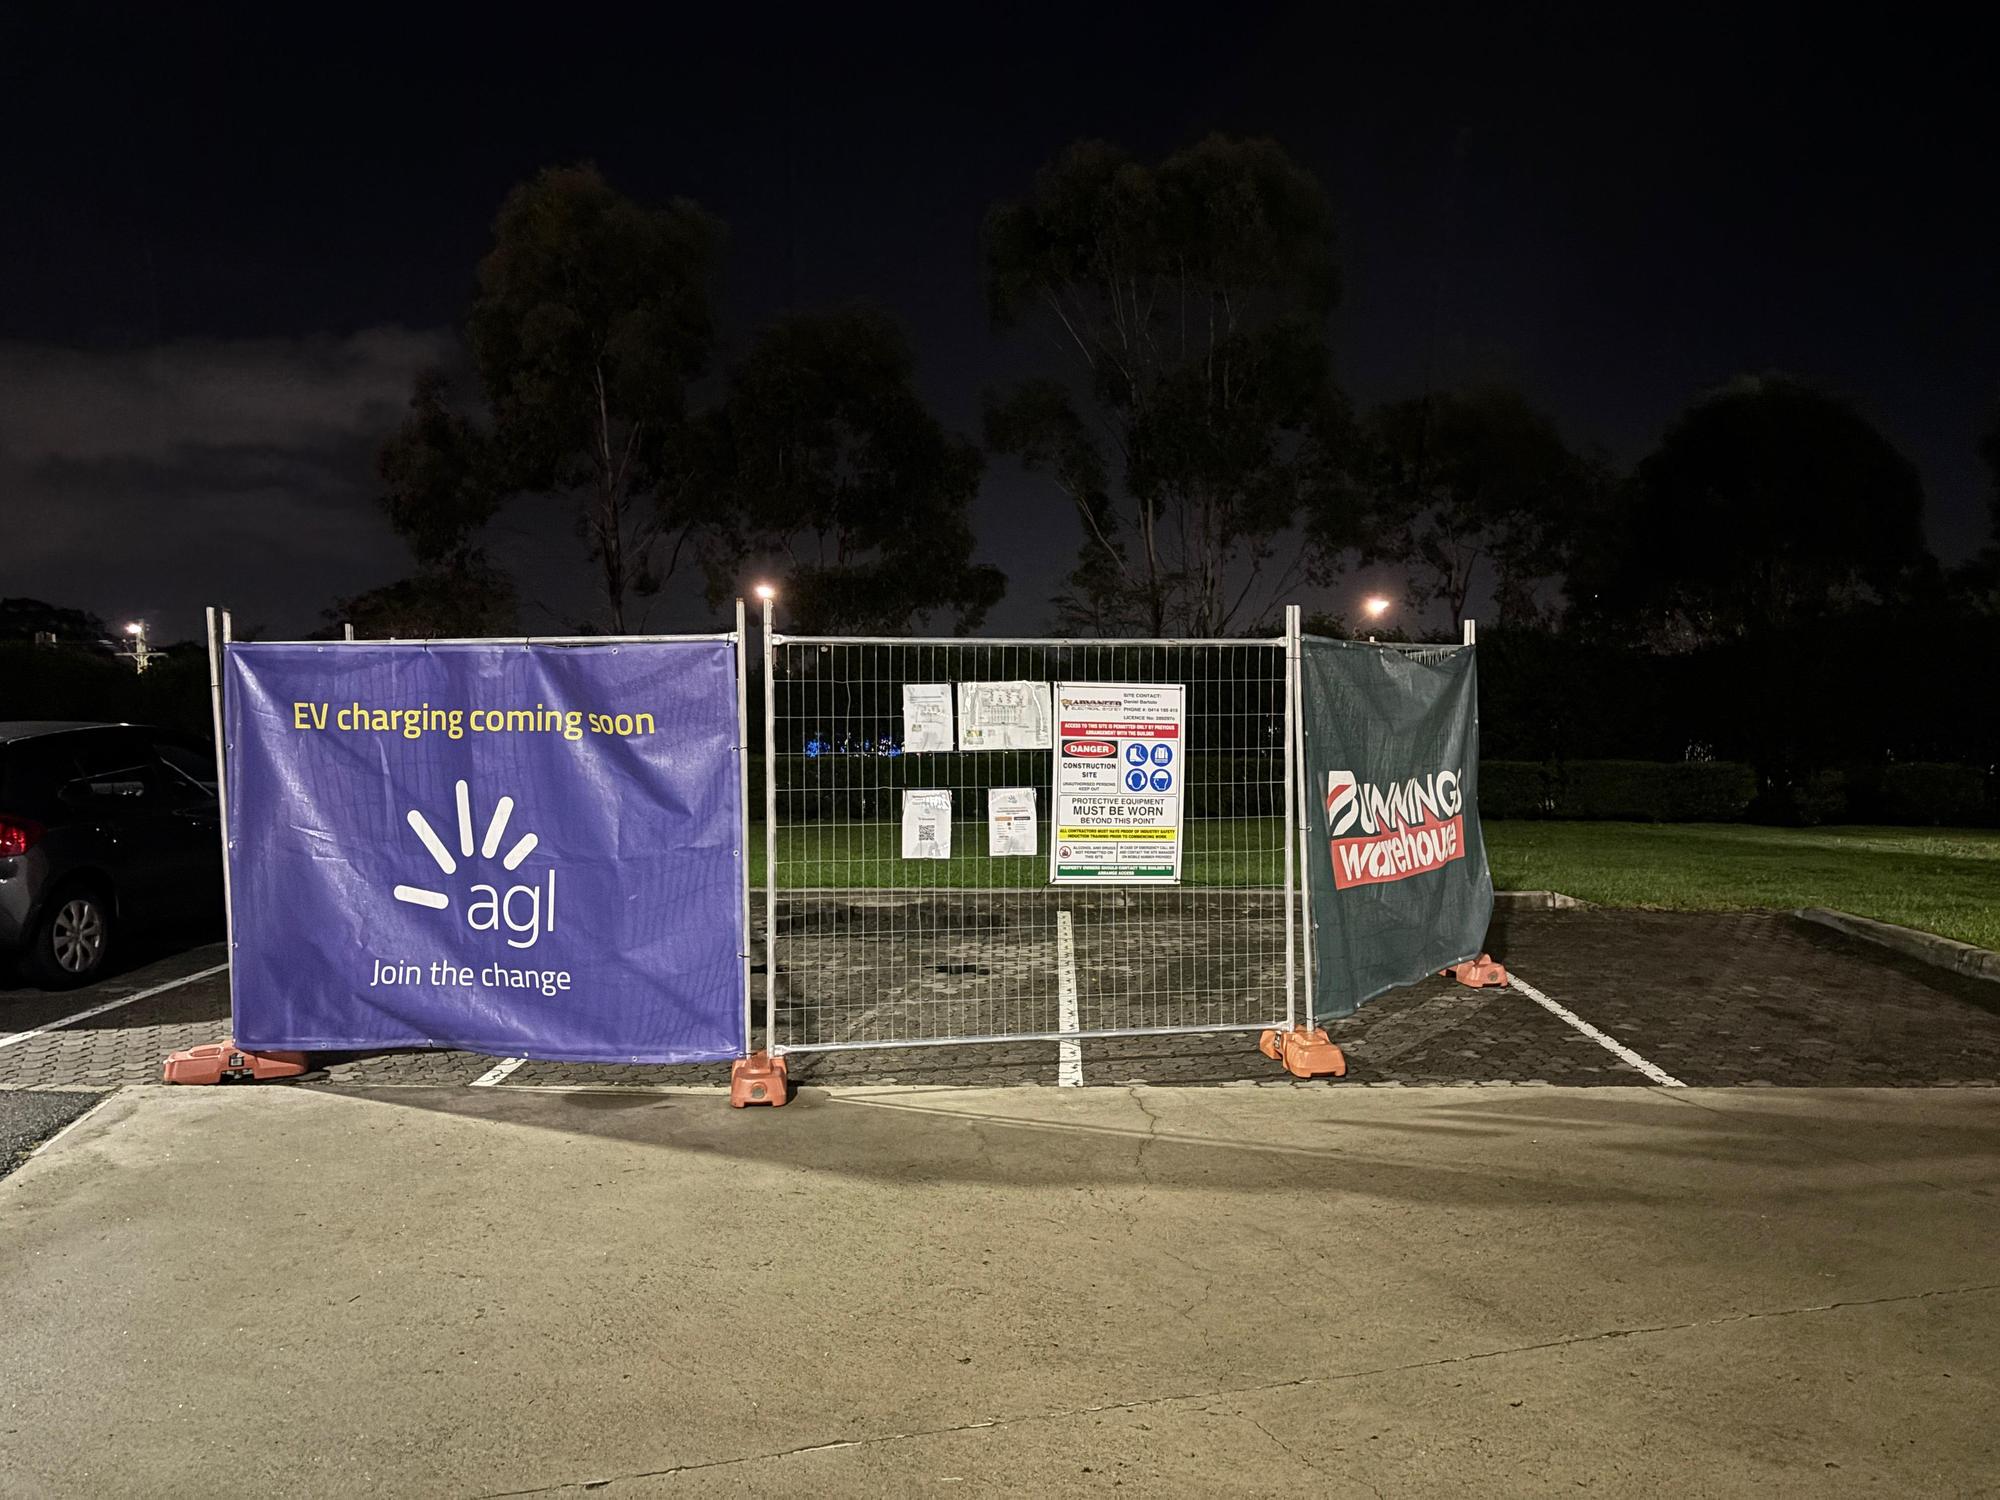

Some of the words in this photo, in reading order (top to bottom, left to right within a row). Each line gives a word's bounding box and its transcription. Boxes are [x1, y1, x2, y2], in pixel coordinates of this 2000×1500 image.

[294, 702, 329, 730] EV
[337, 702, 464, 740] charging
[469, 703, 583, 742] coming
[588, 713, 655, 736] soon
[1070, 745, 1109, 753] DANGER
[1073, 806, 1106, 815] MUST
[1109, 806, 1124, 816] BE
[1128, 806, 1163, 816] WORN
[1327, 768, 1462, 836] BUNNINGS
[467, 869, 555, 949] agl
[370, 960, 421, 986] Join
[430, 960, 474, 986] the
[481, 962, 571, 997] change
